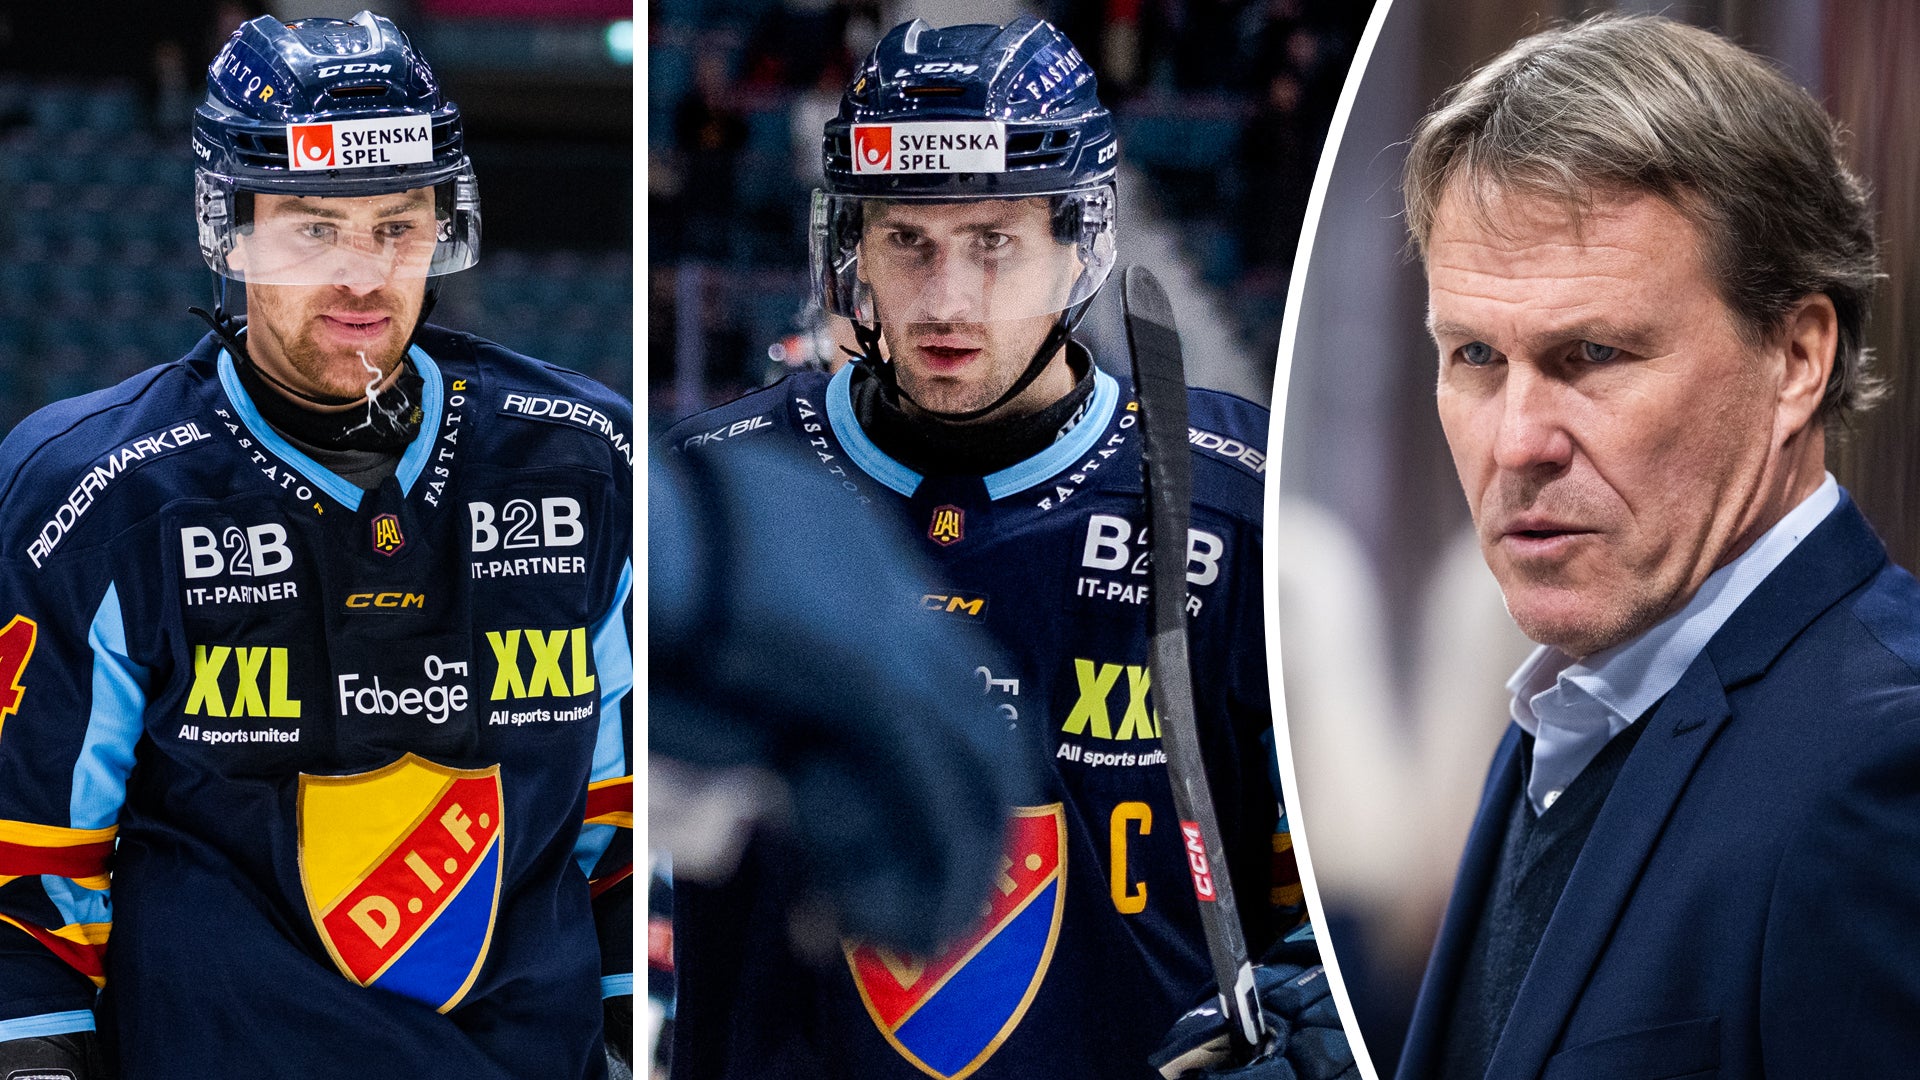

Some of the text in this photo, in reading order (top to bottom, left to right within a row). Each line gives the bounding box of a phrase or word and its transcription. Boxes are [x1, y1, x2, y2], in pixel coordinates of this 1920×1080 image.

[222, 50, 274, 103] TATOR
[318, 63, 392, 78] CCM
[192, 136, 211, 161] CCM
[341, 126, 429, 147] SVENSKA
[899, 134, 999, 151] SVENSKA
[342, 148, 391, 165] SPEL
[899, 154, 950, 170] SPEL
[424, 379, 467, 507] FASTATOR
[503, 394, 633, 466] RIDDERMA
[728, 416, 772, 437] BIL
[215, 409, 324, 515] FASTATOR
[26, 422, 211, 569] RIDDERMARK BIL
[468, 497, 585, 552] B2B
[181, 523, 293, 579] B2B
[471, 557, 586, 579] IT-PARTNER
[186, 582, 298, 606] IT-PARTNER
[345, 592, 425, 609] CCM
[920, 594, 985, 616] CM
[184, 644, 301, 718] XXL
[485, 627, 595, 701] XXL
[338, 673, 469, 724] Fabege
[489, 701, 593, 725] All sports united
[1061, 658, 1161, 740] XX
[178, 725, 300, 745] All sports united
[1056, 743, 1168, 767] All sports unite
[346, 802, 490, 950] D.I.F.
[1110, 801, 1153, 914] C
[1182, 825, 1213, 897] CCM
